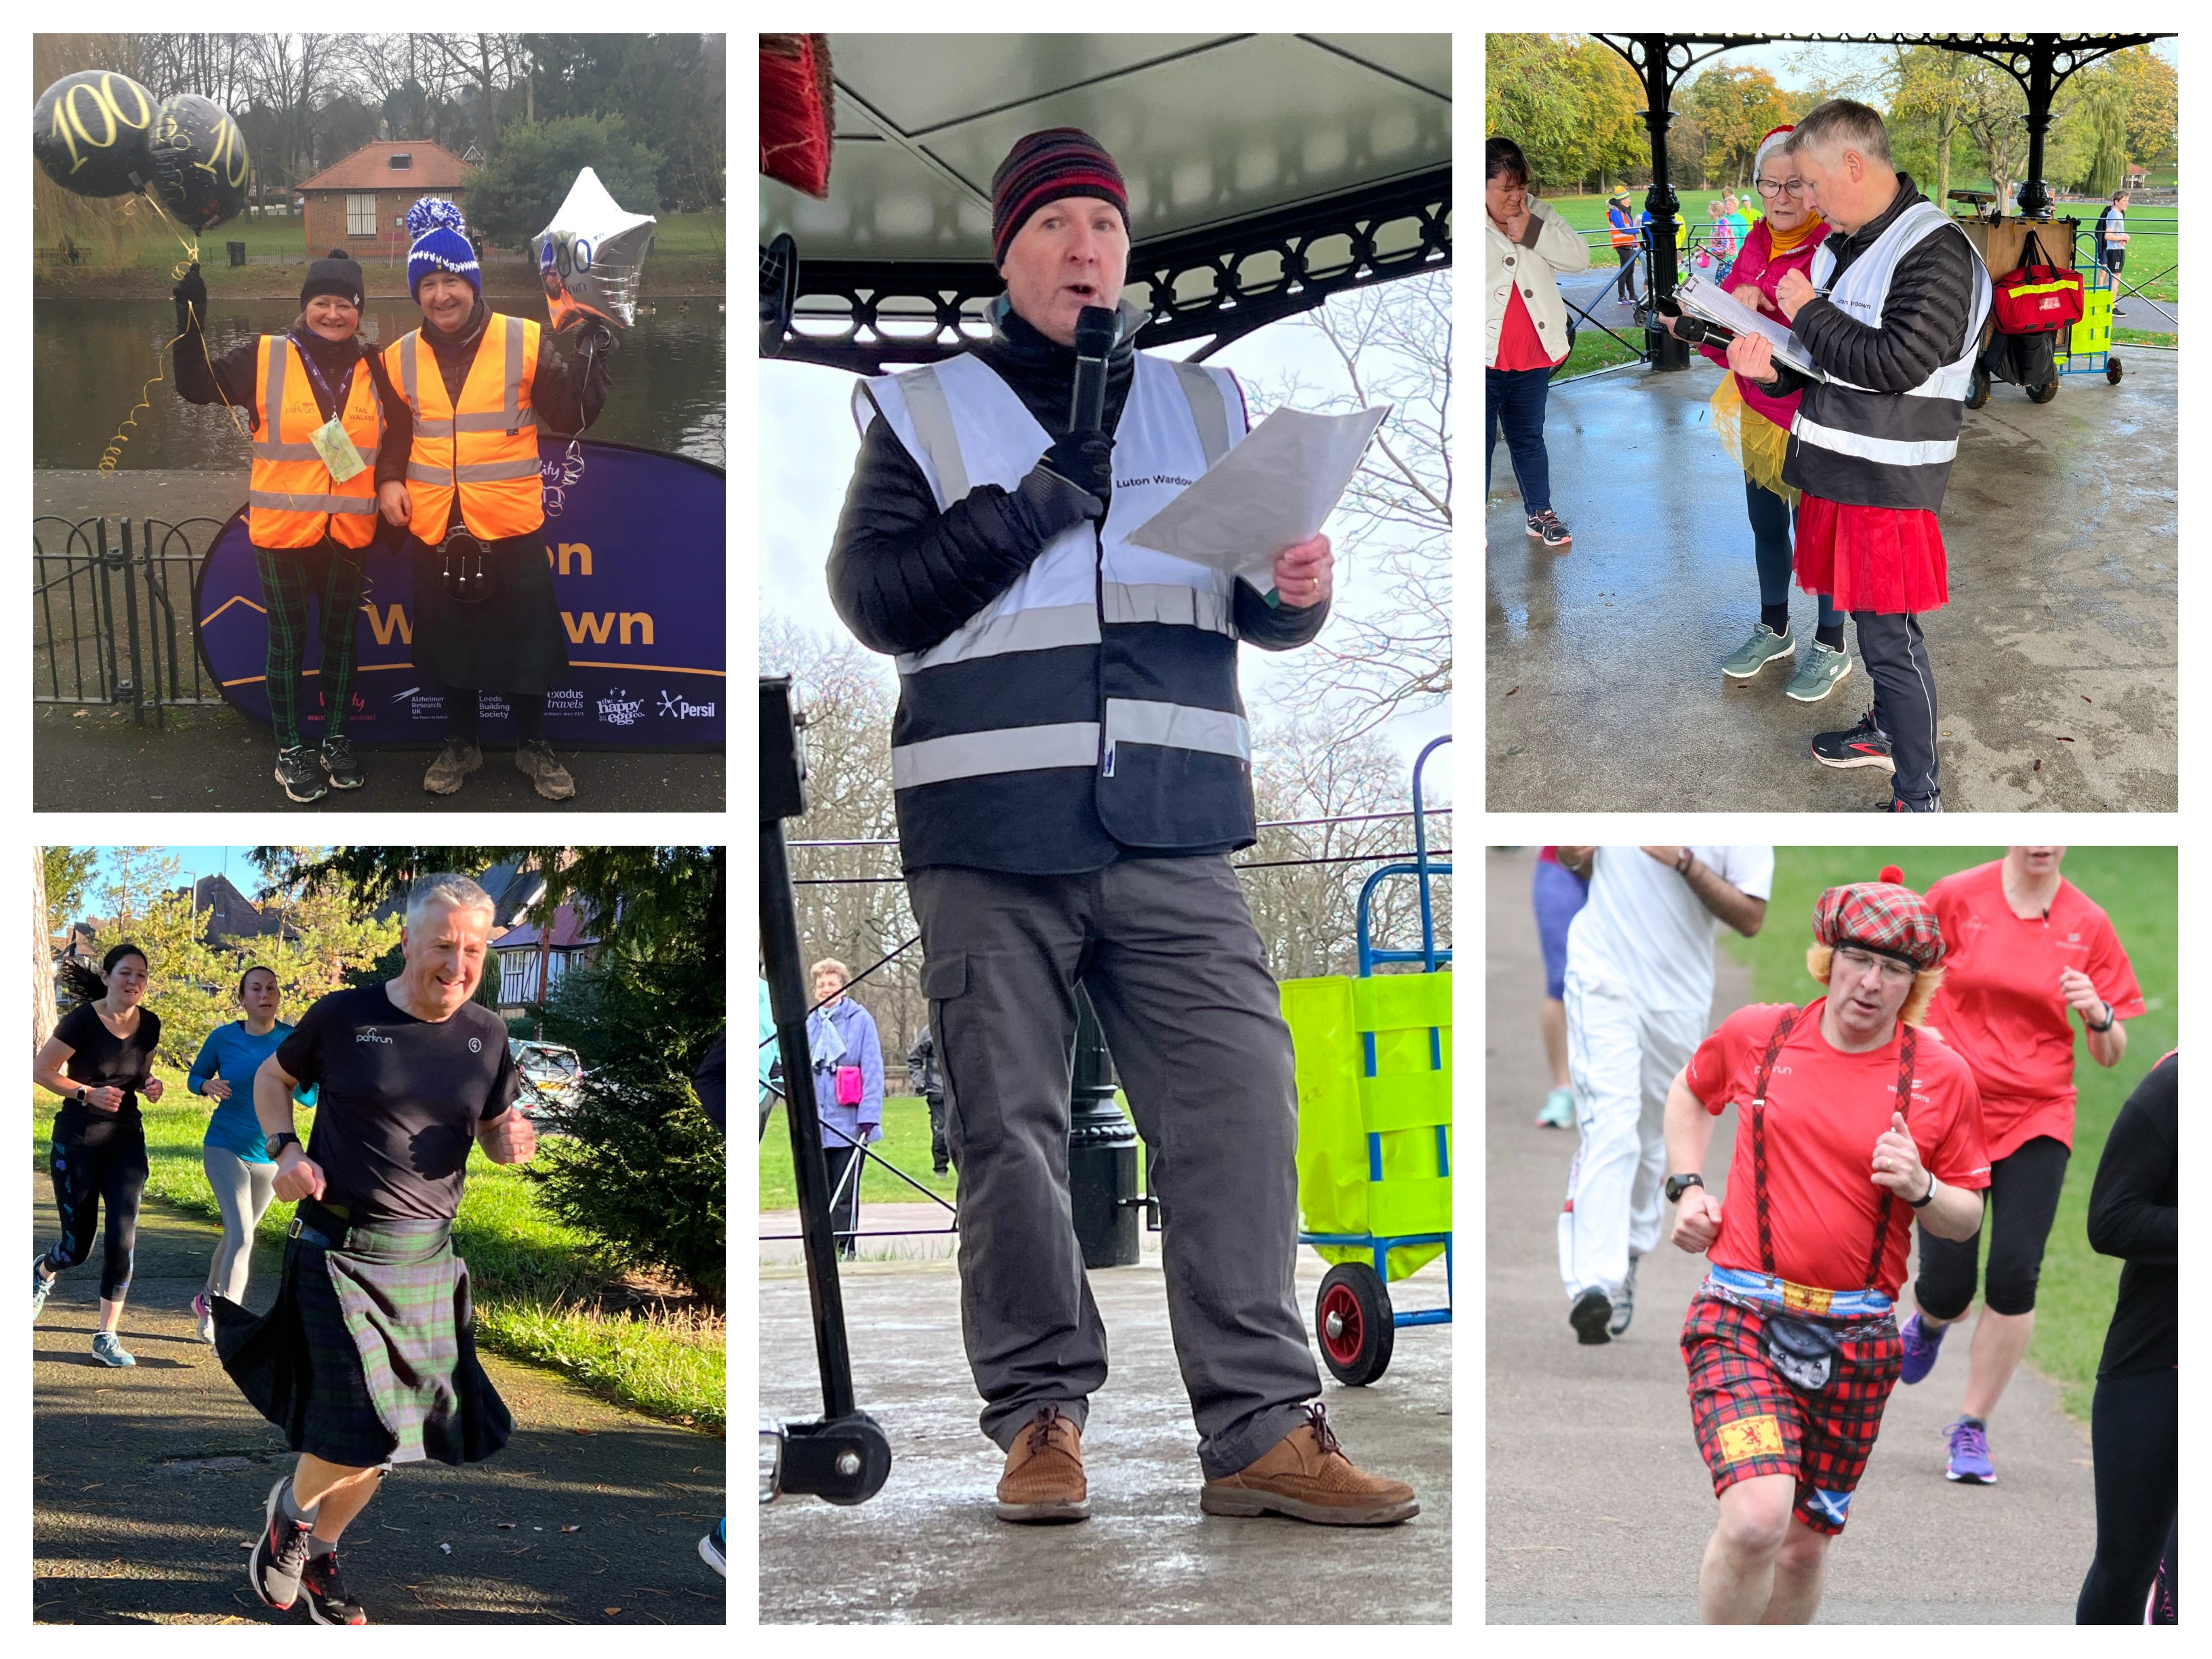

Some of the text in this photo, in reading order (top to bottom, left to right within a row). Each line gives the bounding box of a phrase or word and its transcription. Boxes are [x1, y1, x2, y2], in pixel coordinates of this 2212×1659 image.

[52, 73, 150, 175] 100
[1116, 478, 1150, 488] Luton
[547, 689, 583, 699] exodus
[478, 703, 510, 712] Building
[548, 699, 583, 709] travels
[596, 699, 644, 714] happy
[479, 711, 509, 719] Society
[680, 702, 716, 719] Persil
[607, 712, 634, 725] egg
[356, 1029, 393, 1044] parkrun
